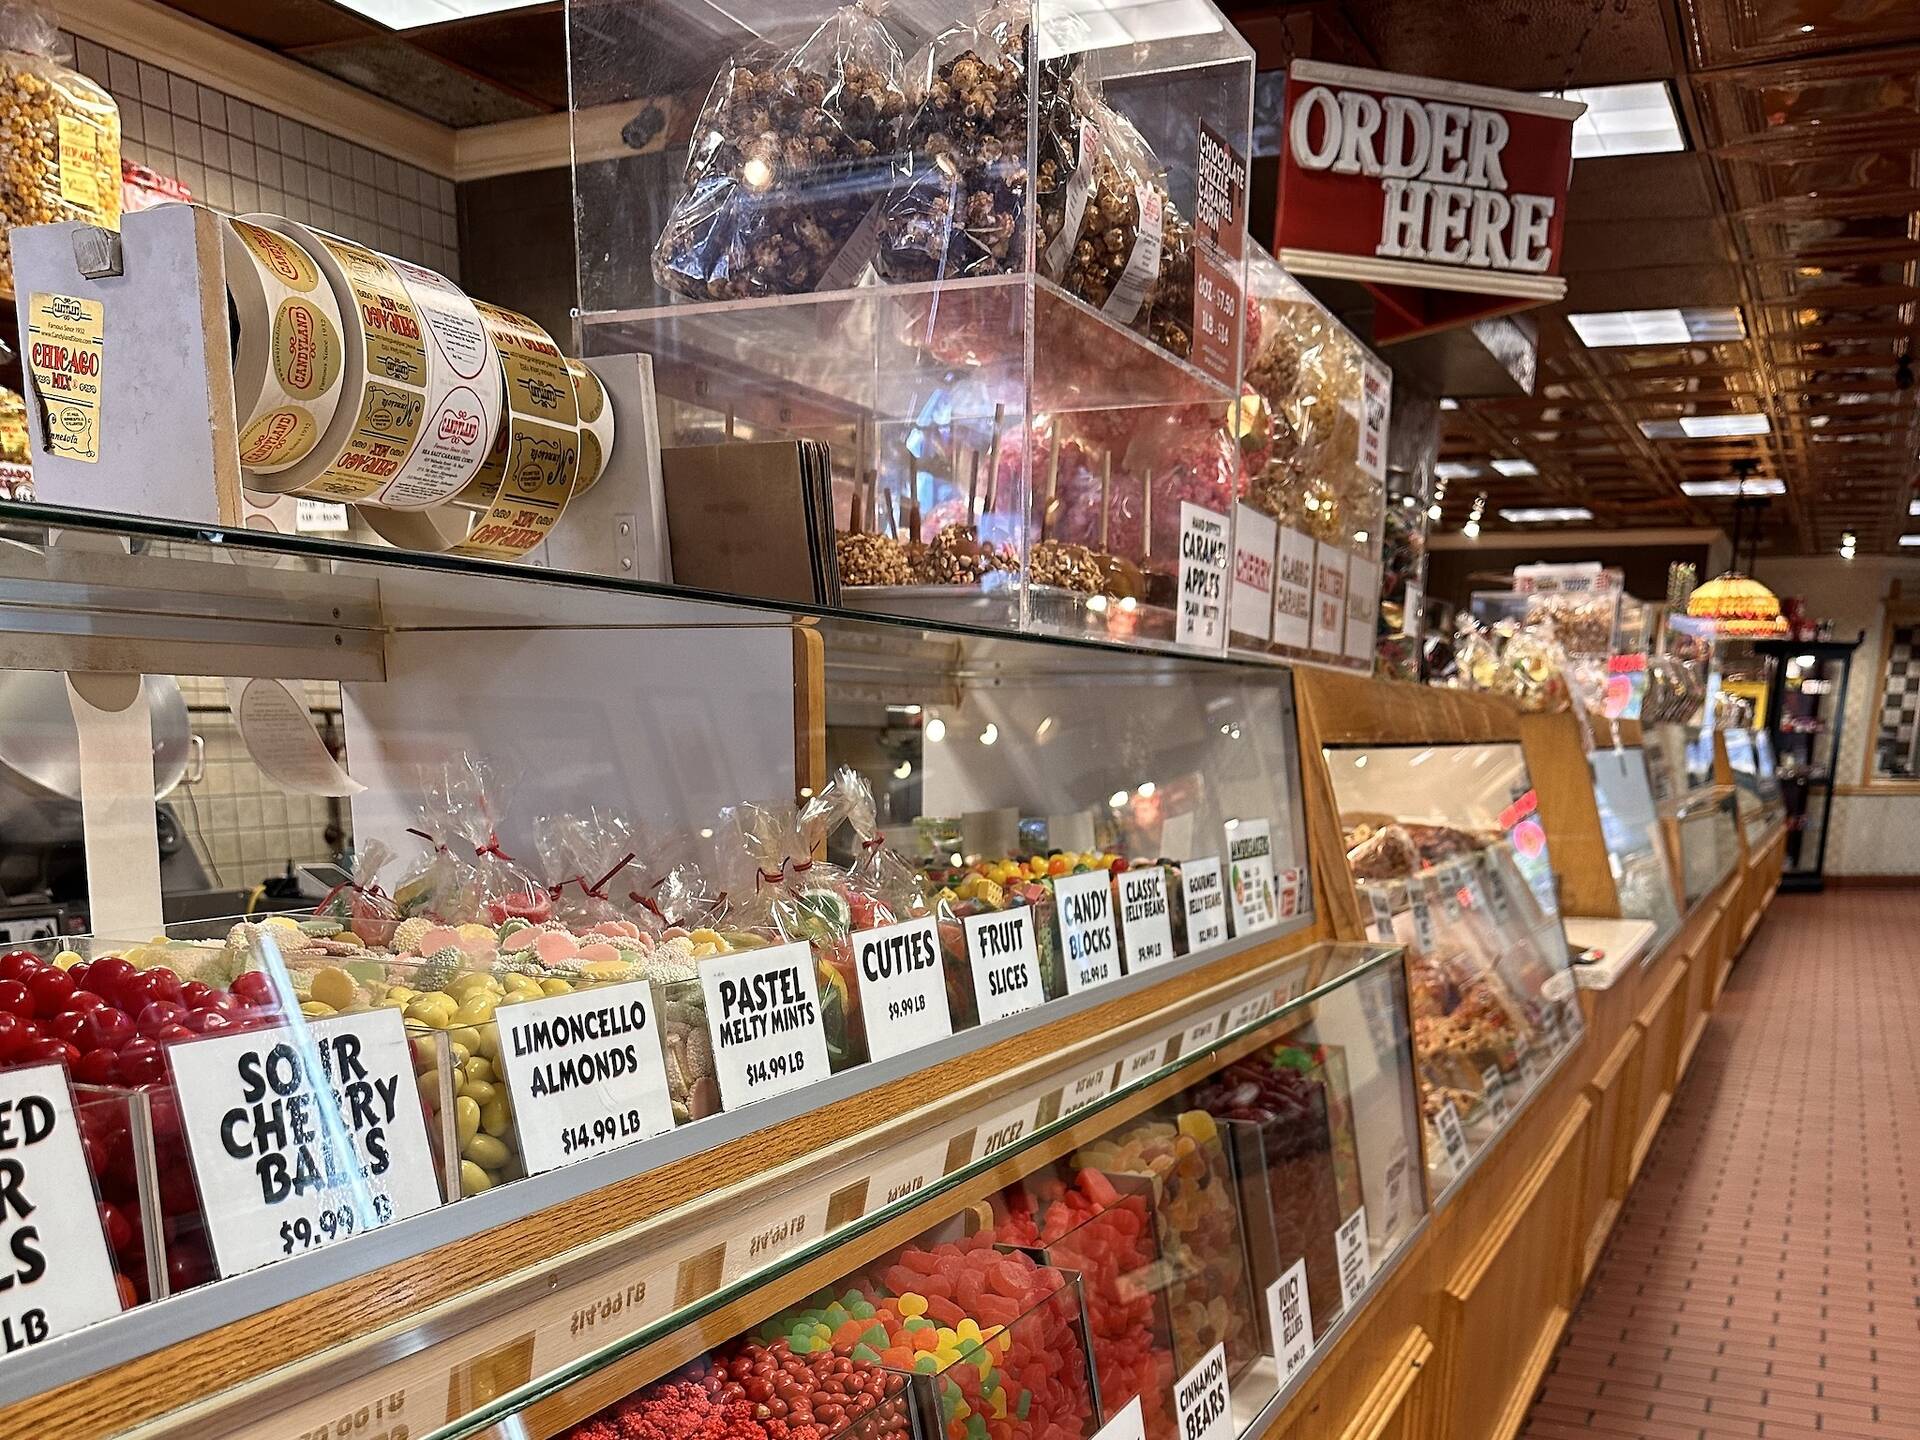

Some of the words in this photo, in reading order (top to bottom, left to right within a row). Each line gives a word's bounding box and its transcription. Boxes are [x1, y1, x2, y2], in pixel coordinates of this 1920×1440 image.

[1290, 86, 1510, 190] ORDER
[1199, 152, 1229, 198] DRIZZLE
[1200, 131, 1245, 190] CHOCOLATE
[1197, 197, 1220, 233] CORN
[1198, 175, 1232, 223] CARAMEL
[1375, 177, 1555, 272] HERE
[362, 303, 420, 341] CHICAGO
[32, 342, 99, 377] CHICAGO
[294, 312, 309, 383] CANDYLAND
[337, 452, 398, 476] CHICAGO
[470, 524, 543, 549] CHICAGO
[1185, 567, 1220, 599] APPLES
[1126, 876, 1161, 903] CLASSIC
[1189, 872, 1217, 893] GOURMET
[1064, 889, 1107, 926] CANDY
[1126, 903, 1144, 923] JELLY
[1144, 899, 1165, 919] BEANS
[1189, 896, 1205, 915] JELLY
[862, 929, 935, 982] CUTIES
[978, 919, 1023, 959] FRUIT
[1069, 926, 1111, 960] BLOCKS
[719, 966, 806, 1019] PASTEL
[988, 963, 1028, 996] SLICES
[1080, 967, 1100, 986] $12.99
[1101, 964, 1108, 979] LB
[720, 1012, 769, 1048] MELTY
[772, 1001, 815, 1035] MINTS
[888, 999, 914, 1021] $9.99
[915, 994, 926, 1012] LB
[512, 1001, 646, 1057] LIMONCELLO
[530, 1044, 638, 1098] ALMONDS
[747, 1056, 787, 1087] $14.99
[789, 1051, 804, 1073] LB
[561, 1116, 617, 1155] $14.99
[619, 1110, 641, 1136] LB
[279, 1204, 355, 1254] $9.99
[2, 1308, 49, 1352] LB
[1180, 1354, 1223, 1413] CINNAMON
[1186, 1383, 1226, 1440] BEARS
